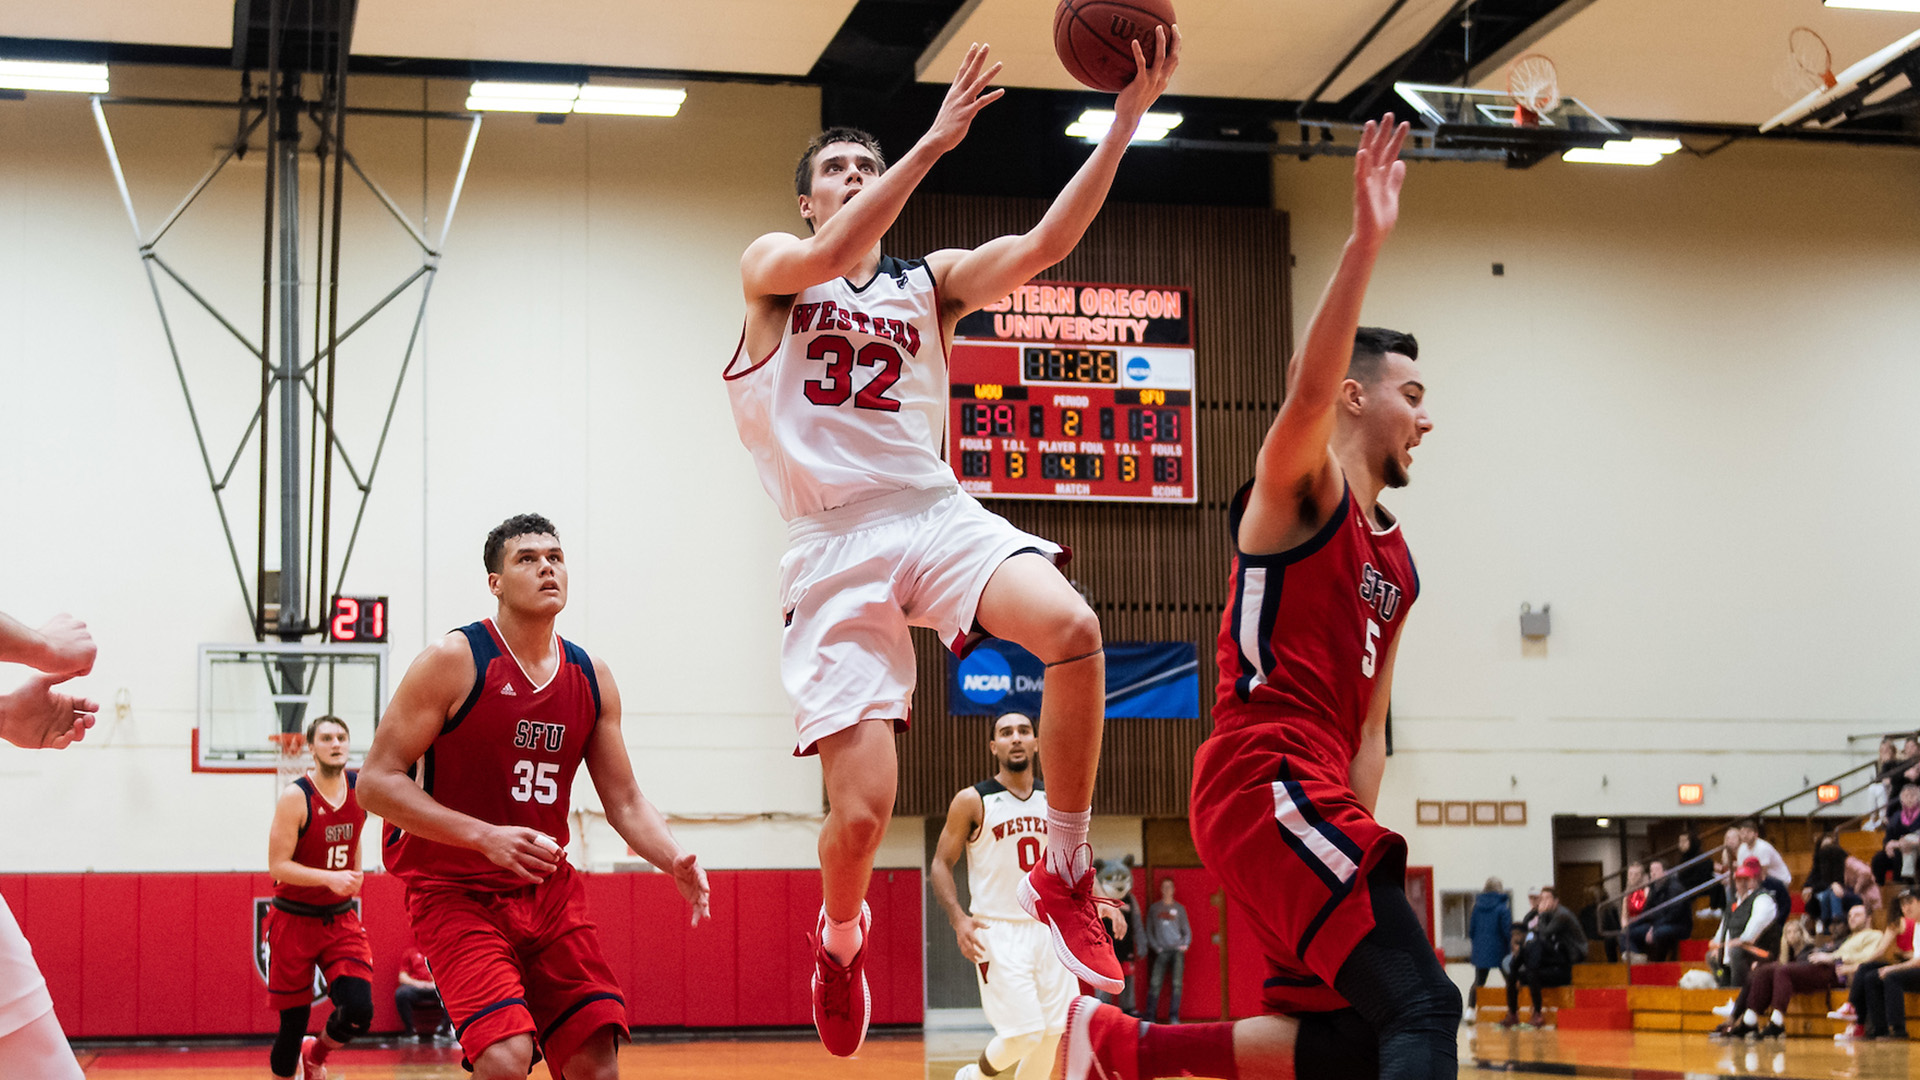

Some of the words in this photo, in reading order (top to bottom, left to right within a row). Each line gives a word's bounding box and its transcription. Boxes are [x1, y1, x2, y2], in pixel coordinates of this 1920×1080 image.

[982, 285, 1075, 314] STERN
[1080, 288, 1181, 318] OREGON
[792, 301, 921, 358] WESTERN
[994, 314, 1148, 342] UNIVERSITY
[803, 335, 903, 412] 32
[974, 384, 1003, 400] WOU
[1053, 395, 1089, 408] PERIOD
[1140, 389, 1165, 406] SFU
[976, 405, 1012, 436] 39
[1063, 410, 1079, 437] 2
[1143, 410, 1178, 441] 31
[960, 438, 992, 451] FOULS
[1038, 440, 1076, 453] PLAYER
[1080, 441, 1105, 454] FOUL
[1151, 444, 1182, 456] FOULS
[1011, 453, 1024, 478] 3
[1123, 456, 1136, 481] 3
[961, 481, 992, 493] SCORE
[1055, 483, 1090, 495] MATCH
[1152, 486, 1183, 498] SCORE
[1359, 562, 1401, 622] SFU
[331, 598, 384, 640] 21
[1362, 617, 1381, 678] 5
[964, 674, 1010, 691] NCAA
[1015, 675, 1045, 692] Divi
[514, 719, 565, 752] SFU
[511, 760, 560, 804] 35
[325, 822, 354, 842] SFU
[992, 816, 1048, 841] WESTE
[326, 844, 349, 869] 15
[1017, 836, 1041, 873] 0
